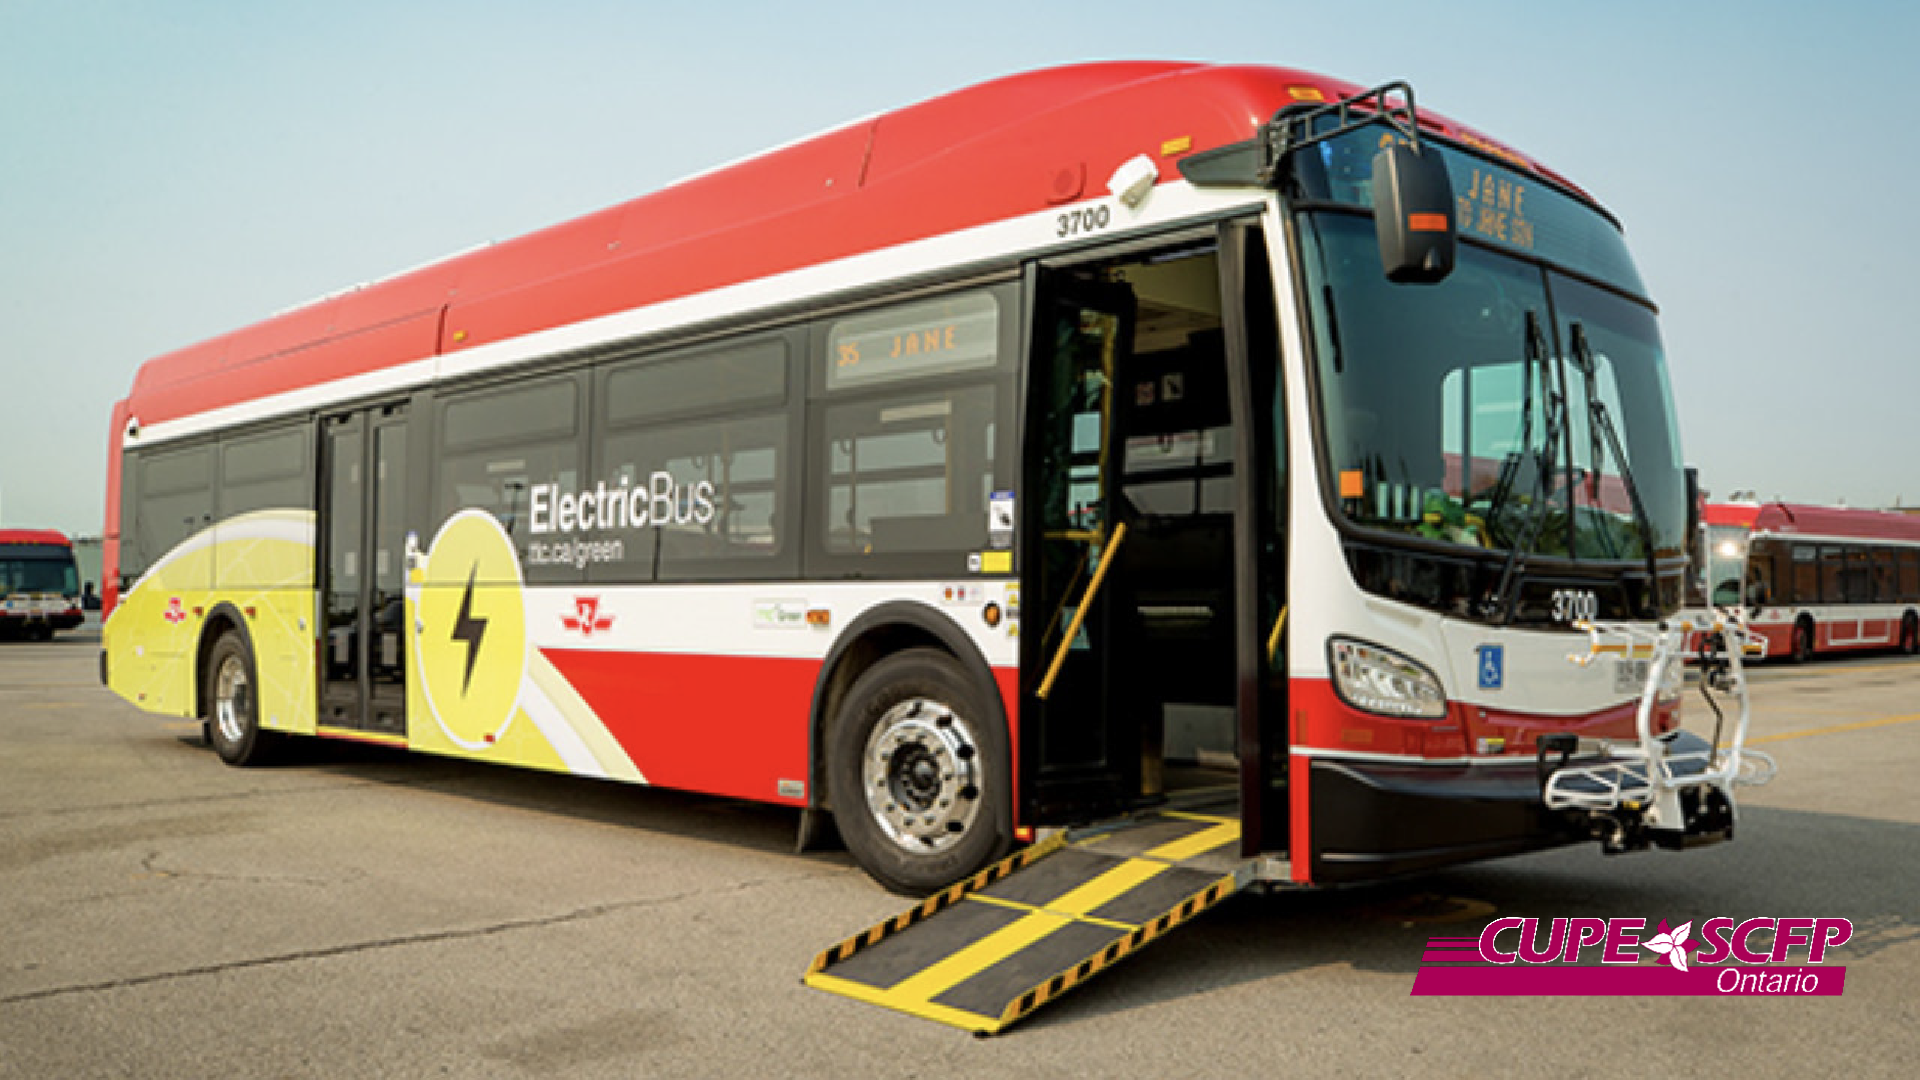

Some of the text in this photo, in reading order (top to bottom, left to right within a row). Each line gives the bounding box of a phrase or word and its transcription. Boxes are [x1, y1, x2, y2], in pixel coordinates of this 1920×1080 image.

[1467, 168, 1525, 217] JANE
[1057, 204, 1110, 237] 3700
[890, 324, 956, 358] JANE
[529, 470, 715, 534] ElectricBus
[1551, 588, 1598, 621] 3700
